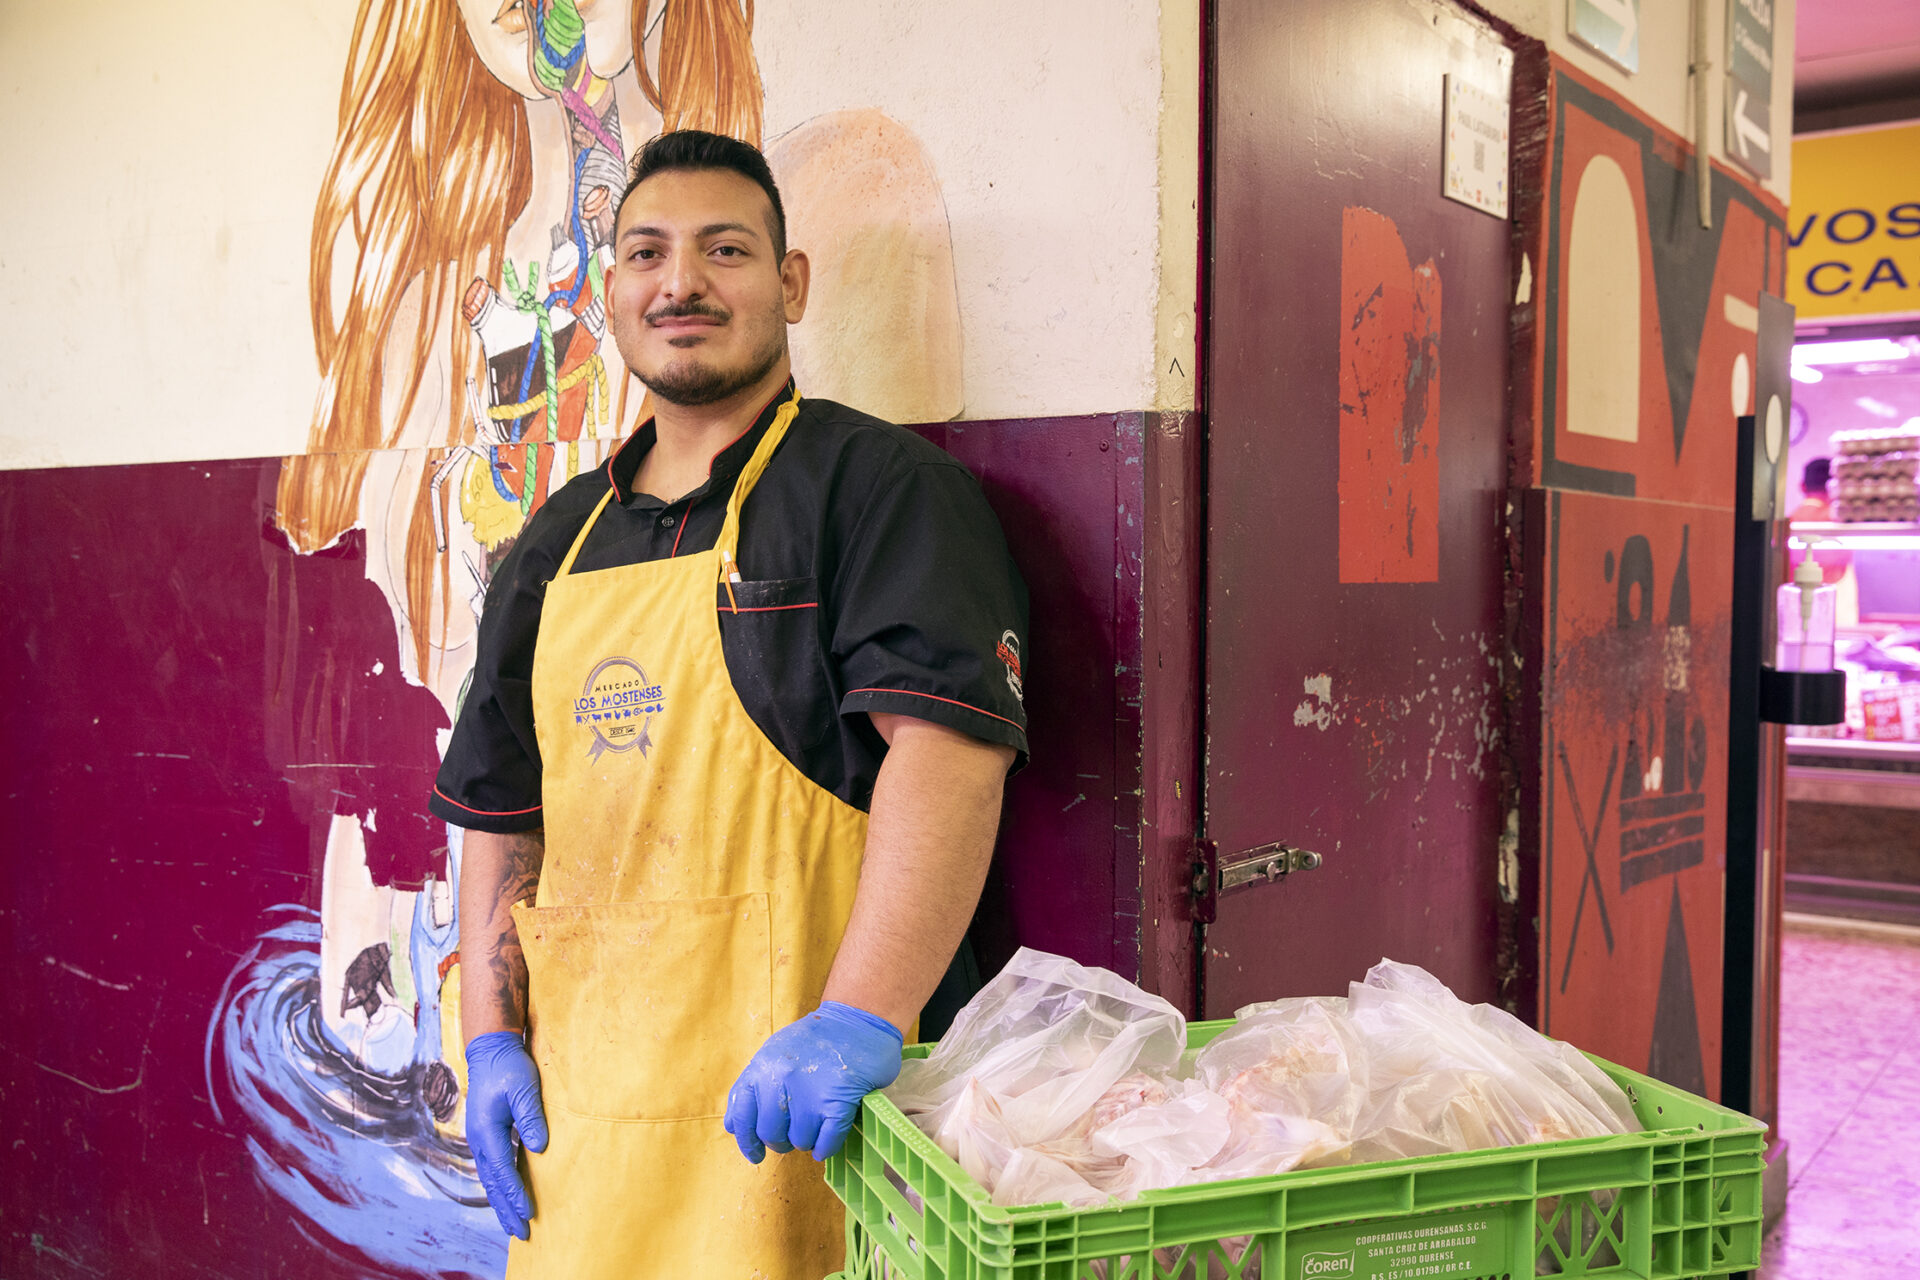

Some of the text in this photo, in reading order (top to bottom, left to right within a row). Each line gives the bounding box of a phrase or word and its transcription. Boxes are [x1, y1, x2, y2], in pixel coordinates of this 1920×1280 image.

[1805, 257, 1920, 297] CA
[595, 680, 639, 692] MERCADO
[574, 685, 662, 711] LOS MOSTENSES
[1355, 1230, 1413, 1246] COOPERATIVAS
[1368, 1235, 1476, 1258] SANTA CRUZ DE ARRABALDO
[1390, 1250, 1455, 1267] 32990 OURENSE
